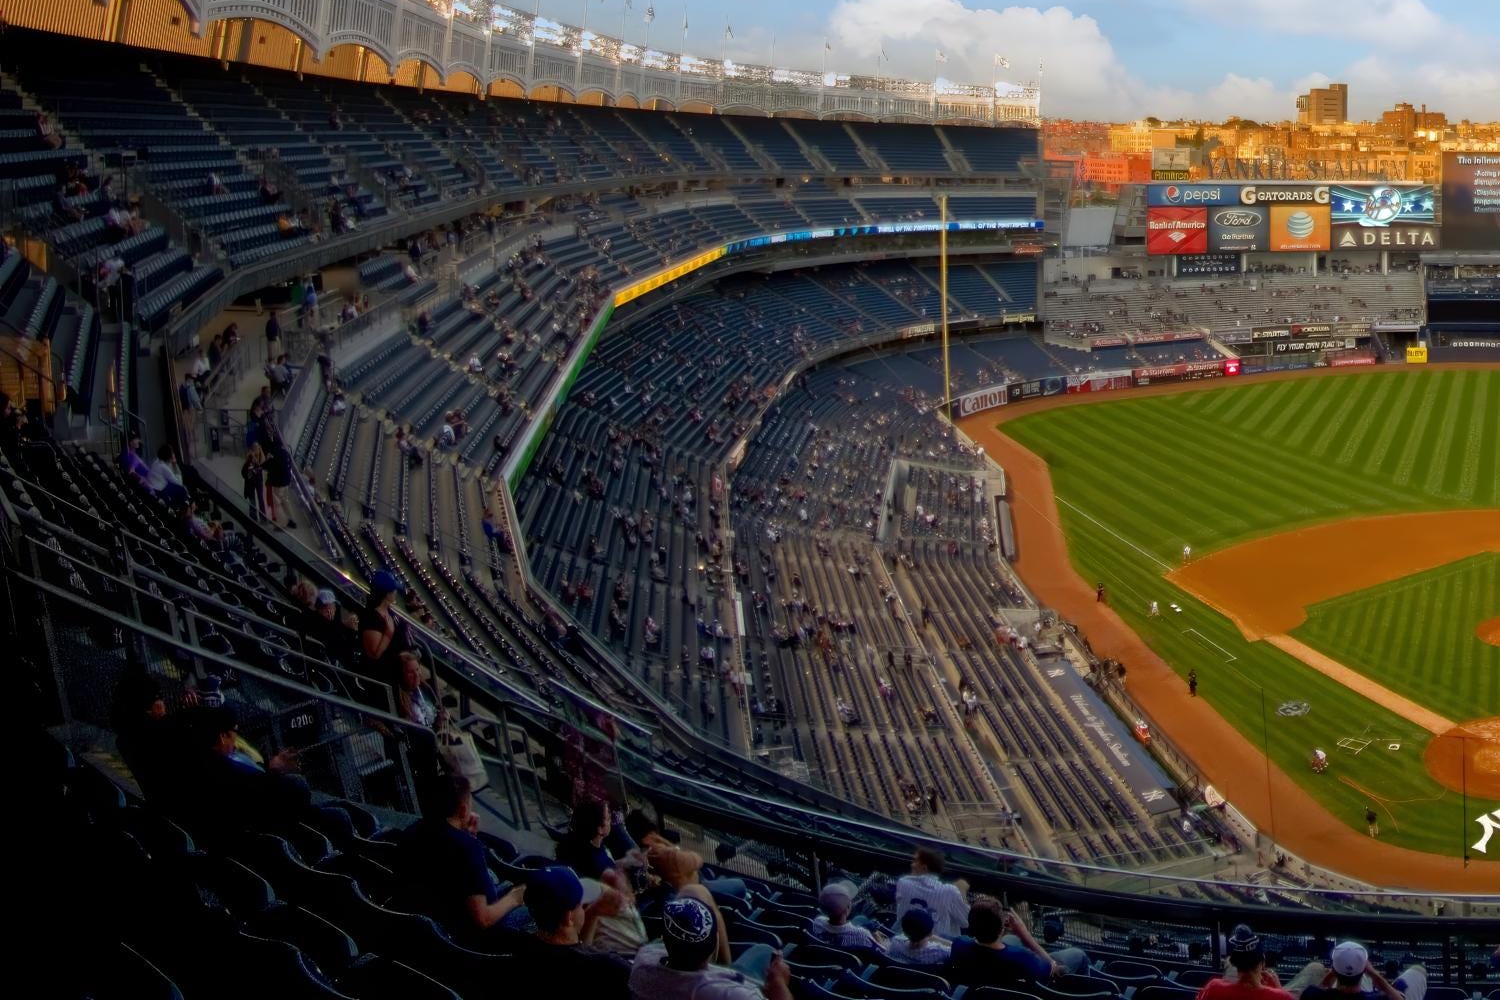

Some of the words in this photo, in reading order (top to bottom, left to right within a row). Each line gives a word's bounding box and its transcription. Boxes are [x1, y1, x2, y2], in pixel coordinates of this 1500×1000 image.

[1184, 188, 1220, 203] pepsi
[1241, 186, 1256, 205] G
[1257, 191, 1313, 201] GATORADE
[1314, 186, 1330, 204] G
[1223, 213, 1253, 226] Ford
[1363, 232, 1434, 245] DELTA
[961, 390, 1007, 414] Canon
